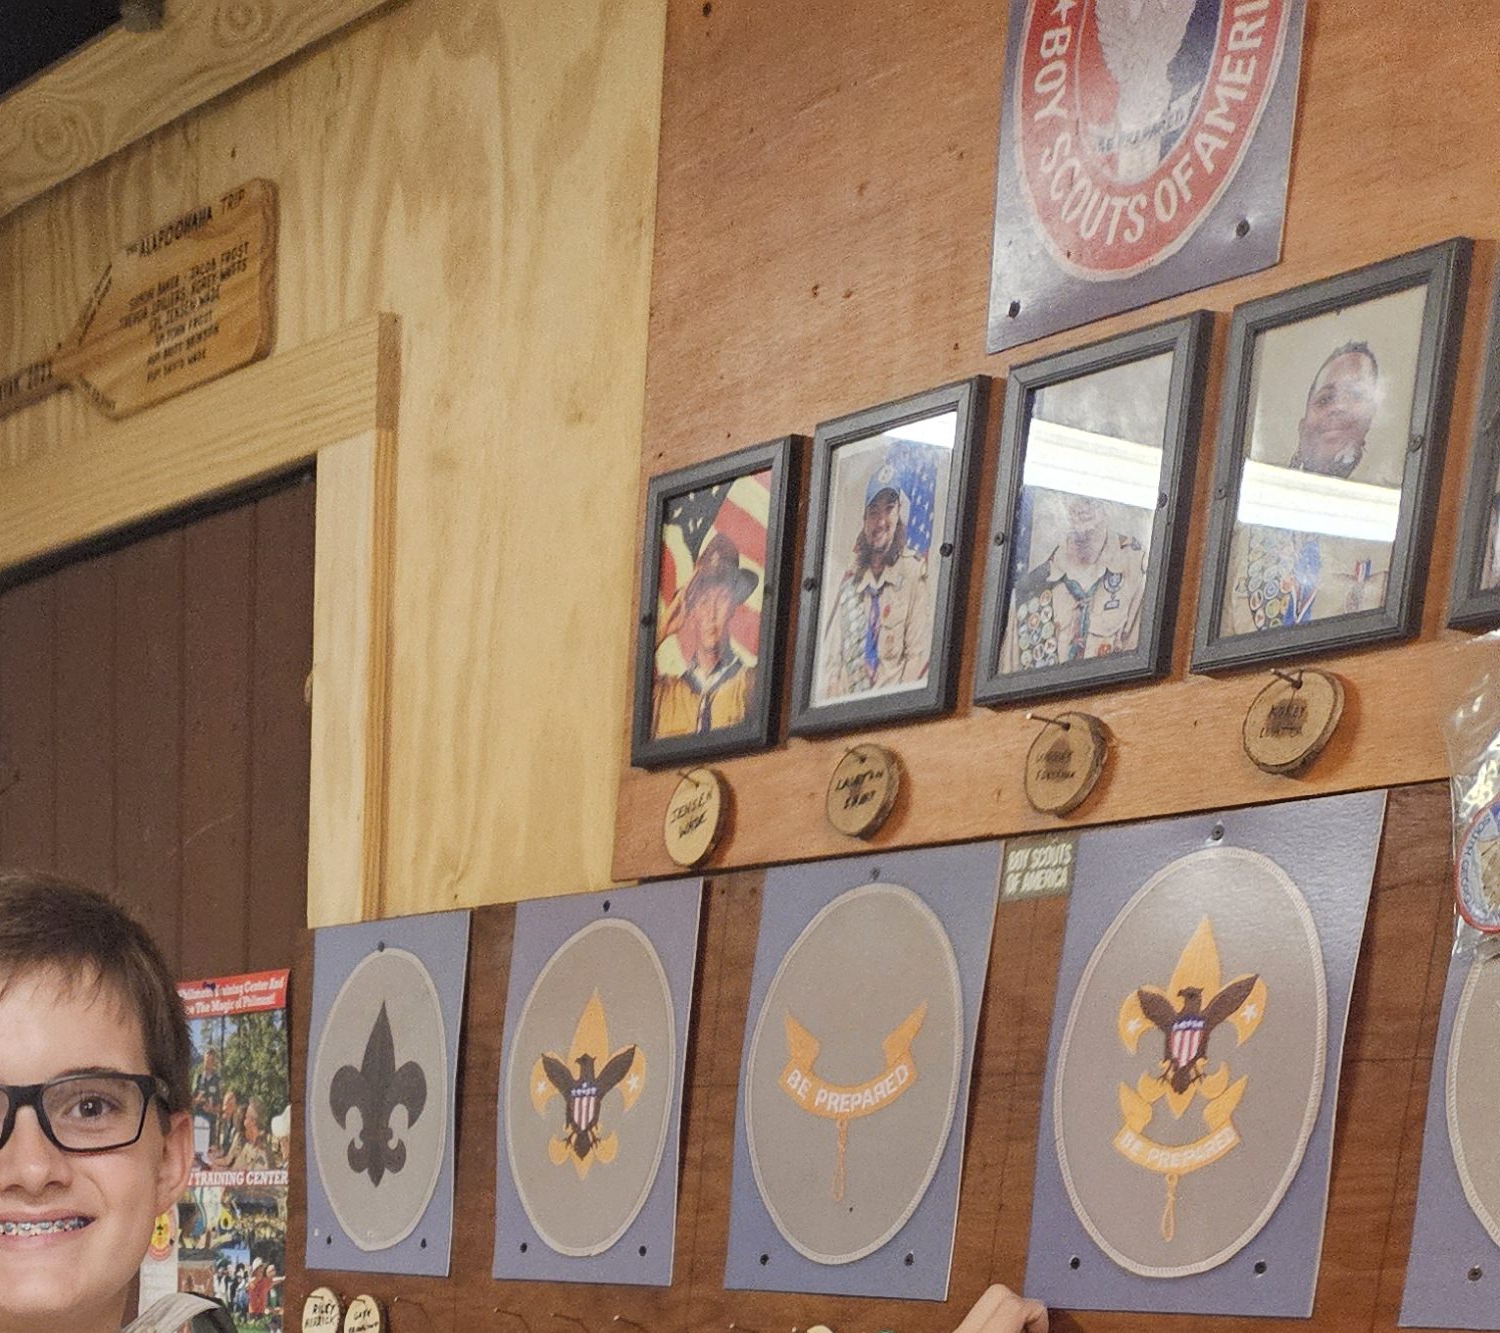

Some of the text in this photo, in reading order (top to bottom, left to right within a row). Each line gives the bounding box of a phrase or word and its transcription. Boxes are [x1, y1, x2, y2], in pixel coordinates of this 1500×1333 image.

[1034, 26, 1071, 121] BOY
[1041, 131, 1148, 246] SCOUTS
[1155, 153, 1194, 222] OF
[1005, 866, 1069, 895] OF AMERICA
[1006, 844, 1074, 872] BOY SCOUTS
[787, 1064, 909, 1113] BE PREPARED
[195, 1170, 289, 1186] TRAINING CENTER
